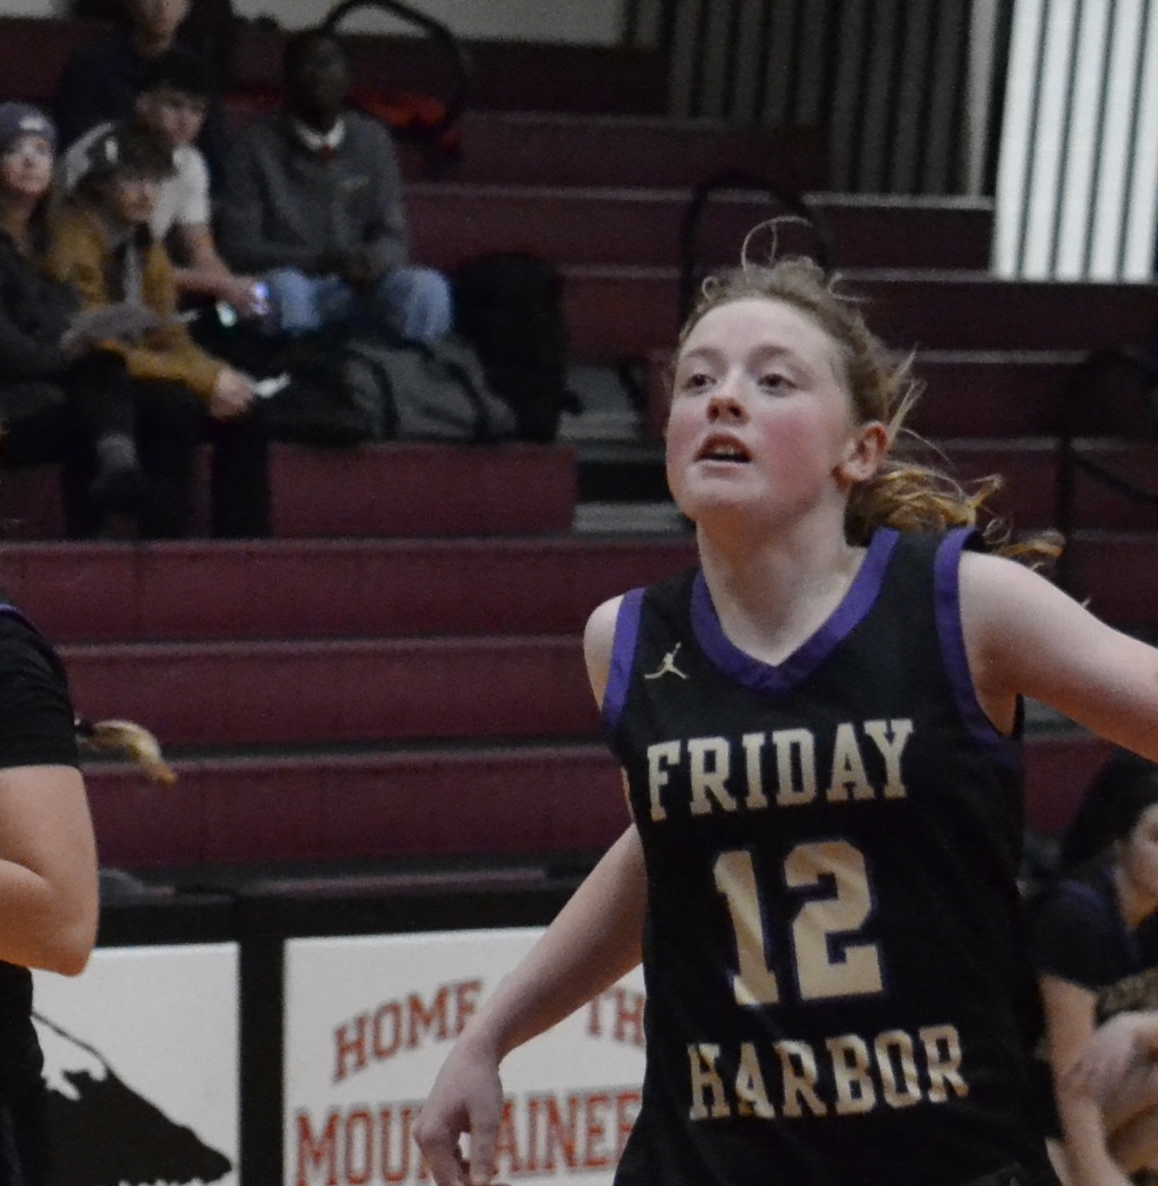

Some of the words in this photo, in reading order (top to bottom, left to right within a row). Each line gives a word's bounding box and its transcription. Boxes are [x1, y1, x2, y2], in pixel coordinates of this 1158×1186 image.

[647, 718, 914, 823] FRIDAY
[712, 840, 884, 1006] 12
[687, 1023, 970, 1122] HARBOR
